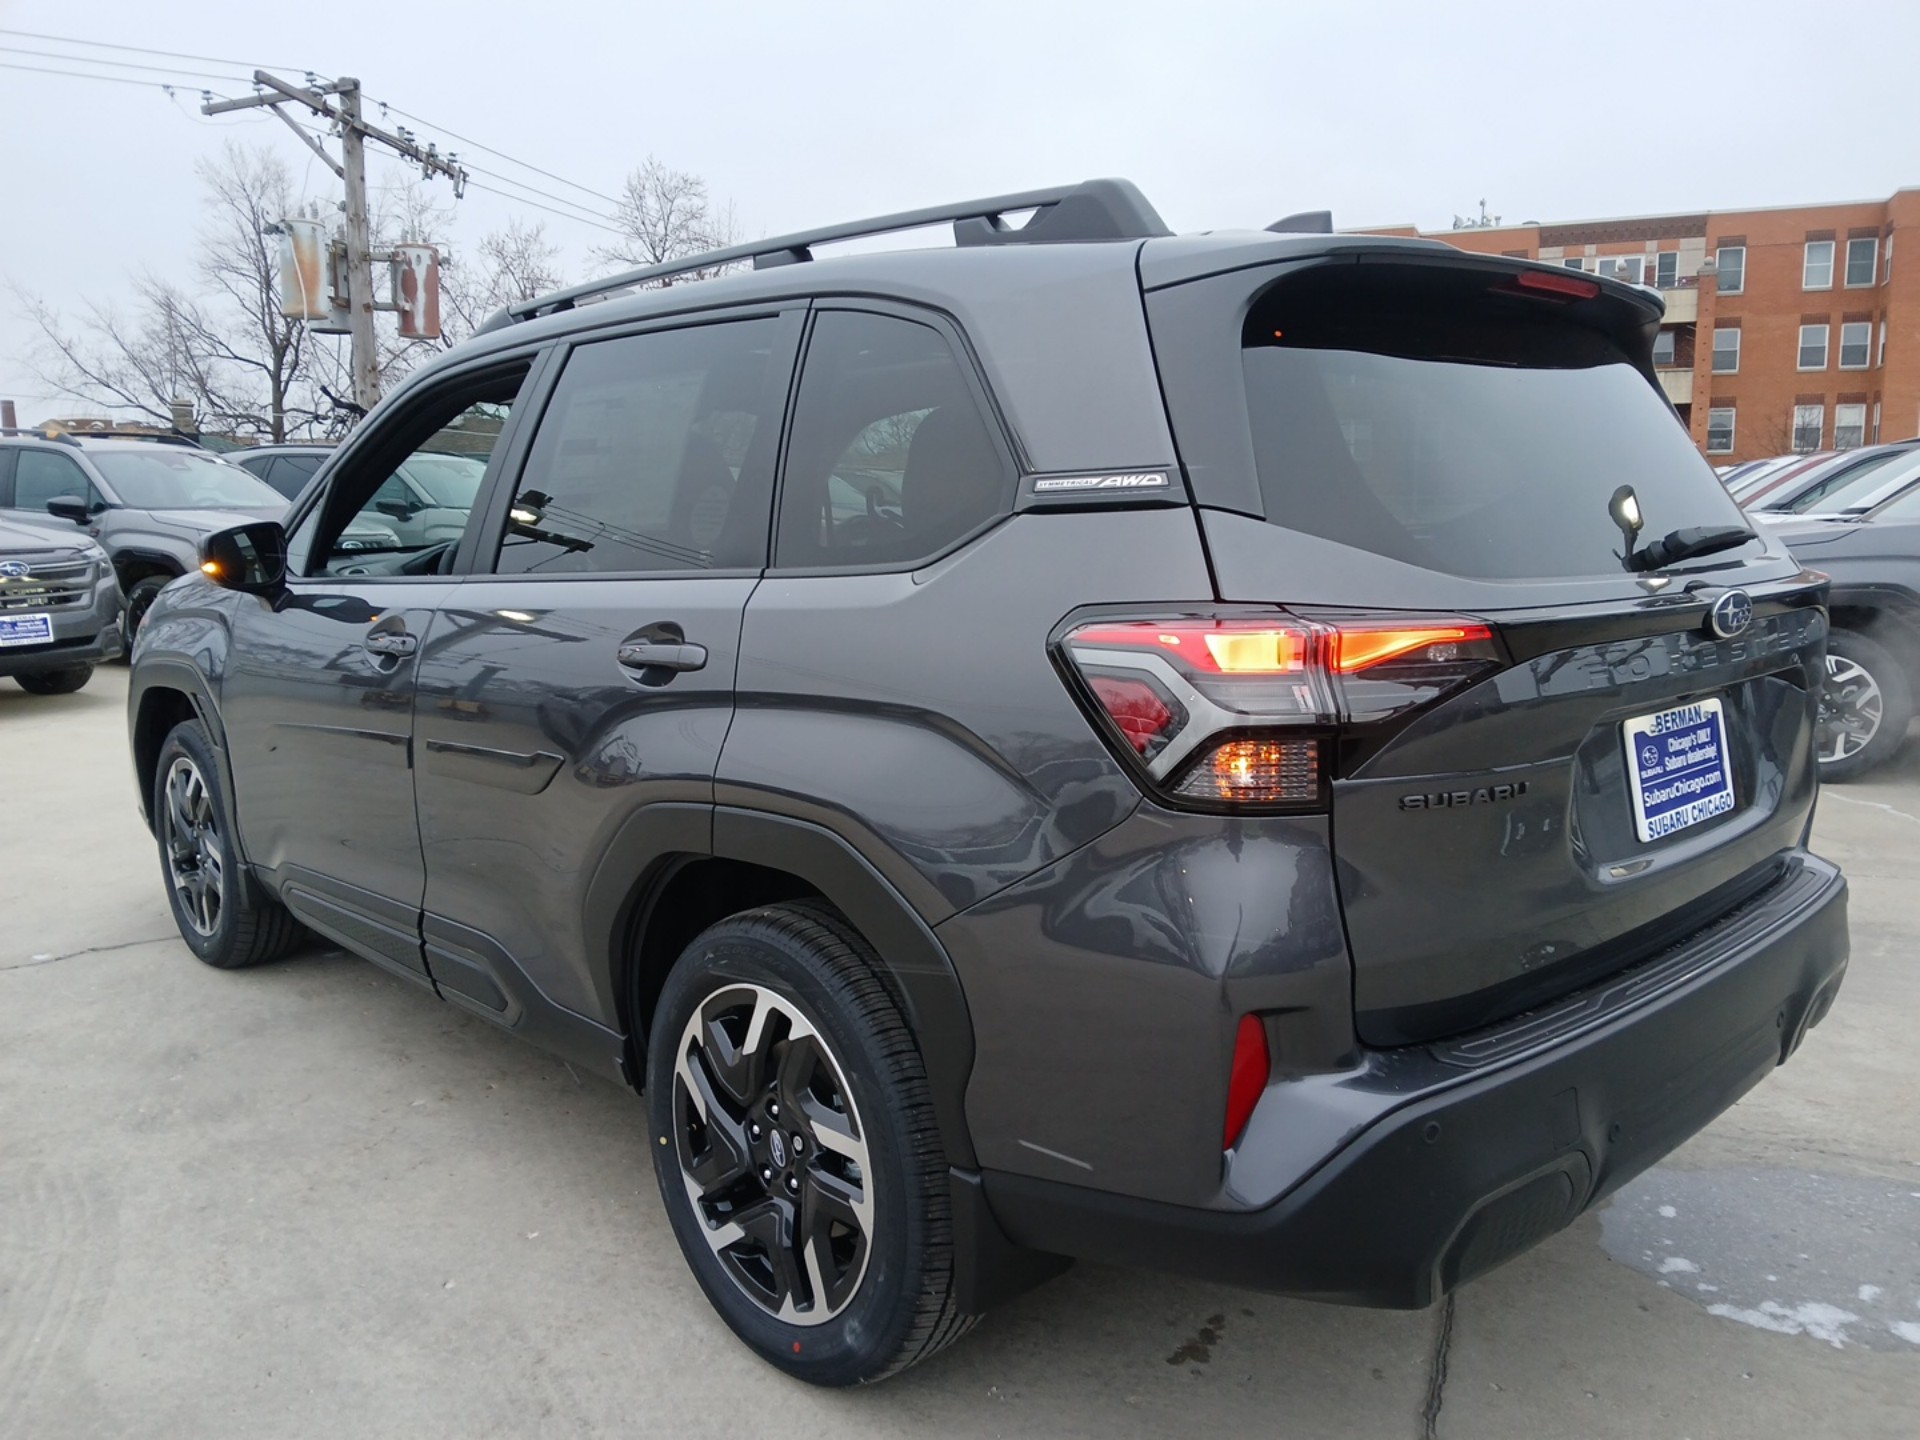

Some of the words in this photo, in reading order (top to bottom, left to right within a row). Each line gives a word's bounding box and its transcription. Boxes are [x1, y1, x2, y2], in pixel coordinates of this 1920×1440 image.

[1098, 474, 1162, 487] AWD
[1655, 705, 1702, 733] BERMAN
[1668, 732, 1697, 752] Chicago's
[1665, 755, 1687, 771] Subaru
[1399, 781, 1530, 811] SUBARU
[1644, 771, 1722, 807] SubaruChicago.com
[1647, 813, 1689, 838] SUBARU
[1691, 792, 1733, 822] CHICAGO
